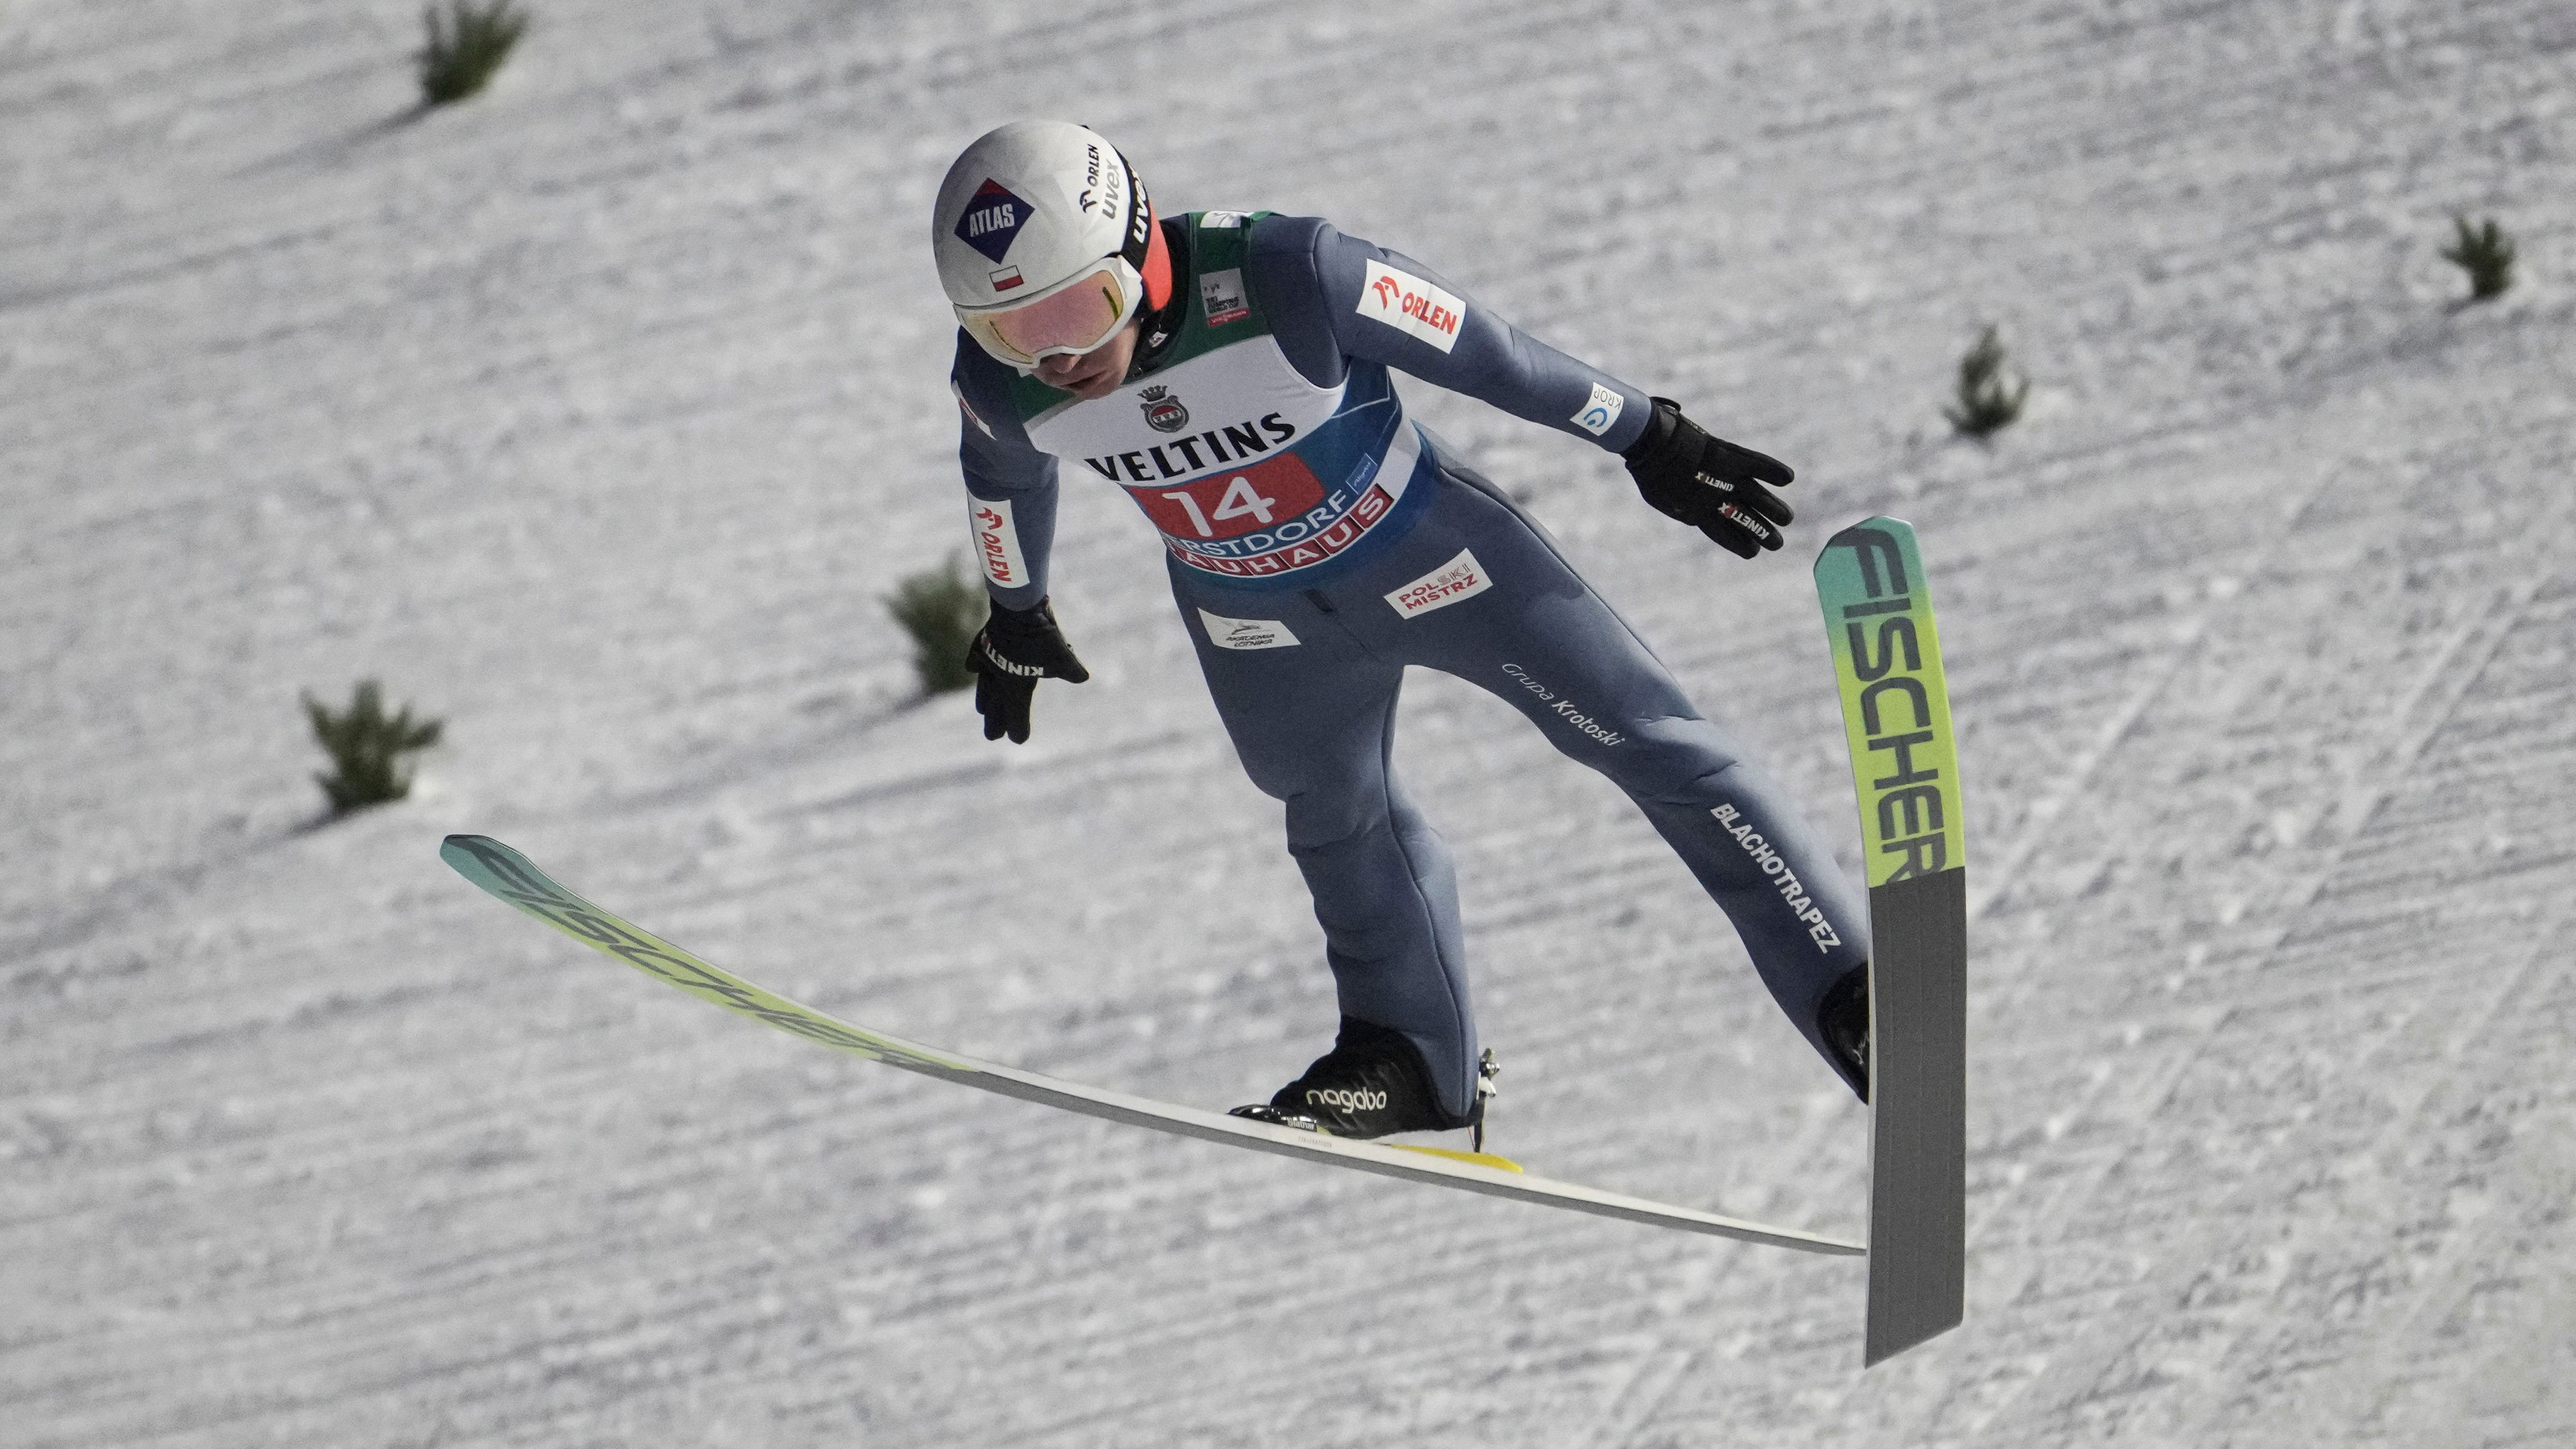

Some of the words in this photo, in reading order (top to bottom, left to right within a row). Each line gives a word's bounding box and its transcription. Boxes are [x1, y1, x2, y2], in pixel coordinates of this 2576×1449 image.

[1086, 143, 1100, 187] ORLEN
[1102, 158, 1120, 219] uvex
[969, 203, 1014, 237] ATLAS
[1401, 292, 1458, 336] ORLEN
[1594, 388, 1622, 410] KROP
[1083, 412, 1296, 482] VELTINS
[1162, 476, 1276, 538] 14
[1164, 489, 1348, 556] RSTDORF
[1166, 492, 1385, 575] AUHAUS
[981, 531, 1012, 582] ORLEN
[1398, 563, 1471, 604] POLSKI
[1405, 573, 1478, 610] MISTRZ
[1501, 662, 1555, 701] Grupa
[1551, 699, 1627, 748] Krotoski
[1825, 527, 1948, 886] FISCHER
[1709, 802, 1842, 954] BLACHOTRAPEZ
[1306, 1086, 1387, 1114] nagabo
